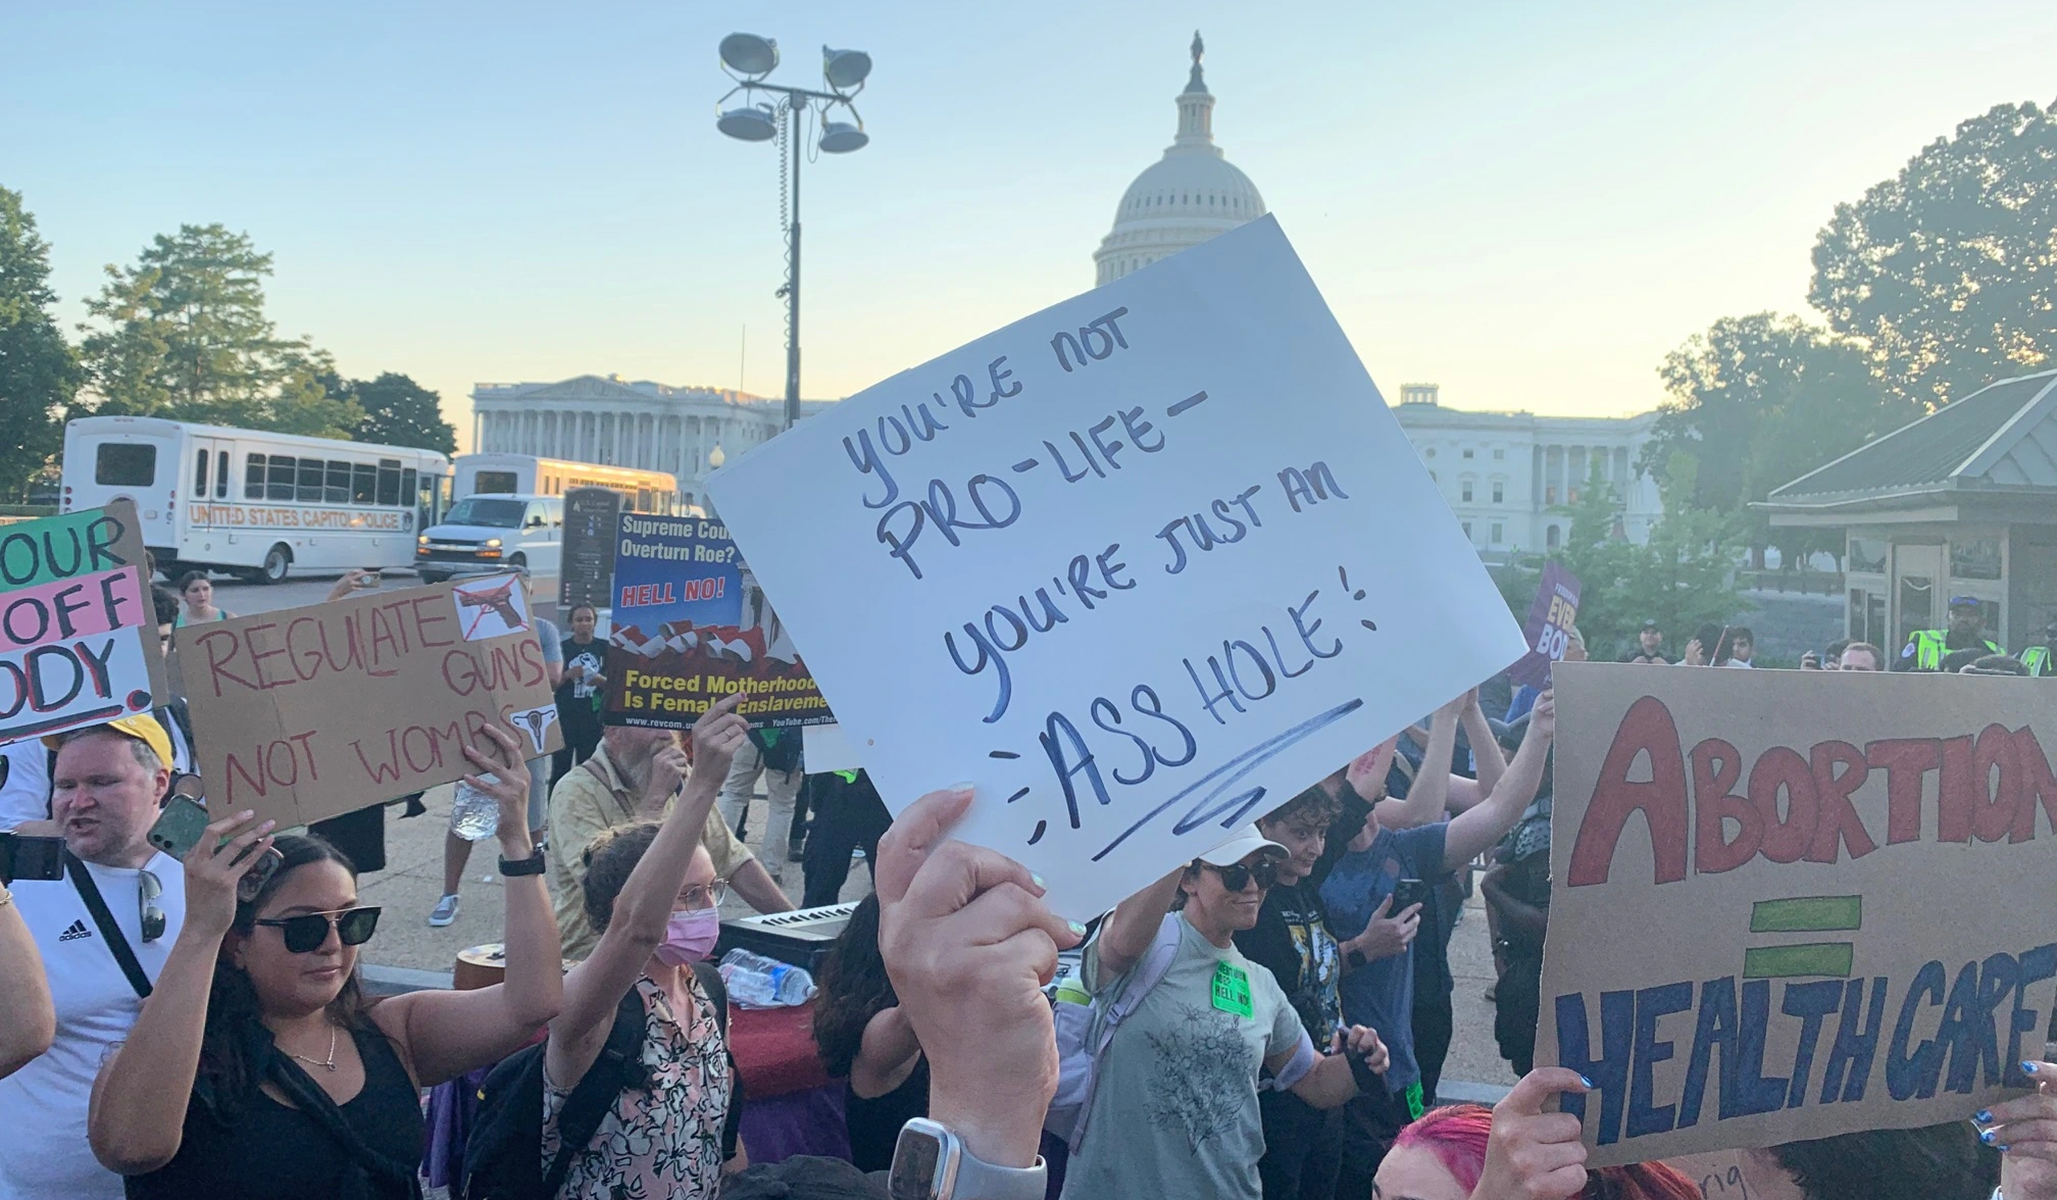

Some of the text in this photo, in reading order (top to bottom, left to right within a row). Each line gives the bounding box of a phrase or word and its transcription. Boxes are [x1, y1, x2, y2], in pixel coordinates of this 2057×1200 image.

[1050, 306, 1129, 372] NOT
[190, 505, 398, 529] UNITED STATES CAPITOL POLICE
[622, 515, 693, 538] Supreme
[1155, 484, 1262, 575] JUST
[1276, 460, 1350, 513] AN
[0, 516, 127, 586] OUR
[621, 539, 736, 563] Overturn Roe?
[3, 572, 129, 645] OFF
[620, 577, 726, 608] HELL NO!
[195, 594, 455, 699] REGULATE
[442, 639, 545, 697] GUNS
[624, 690, 644, 708] Is
[650, 692, 718, 713] Femal
[625, 669, 701, 692] Forced
[225, 730, 319, 805] NOT
[59, 931, 92, 942] adidas
